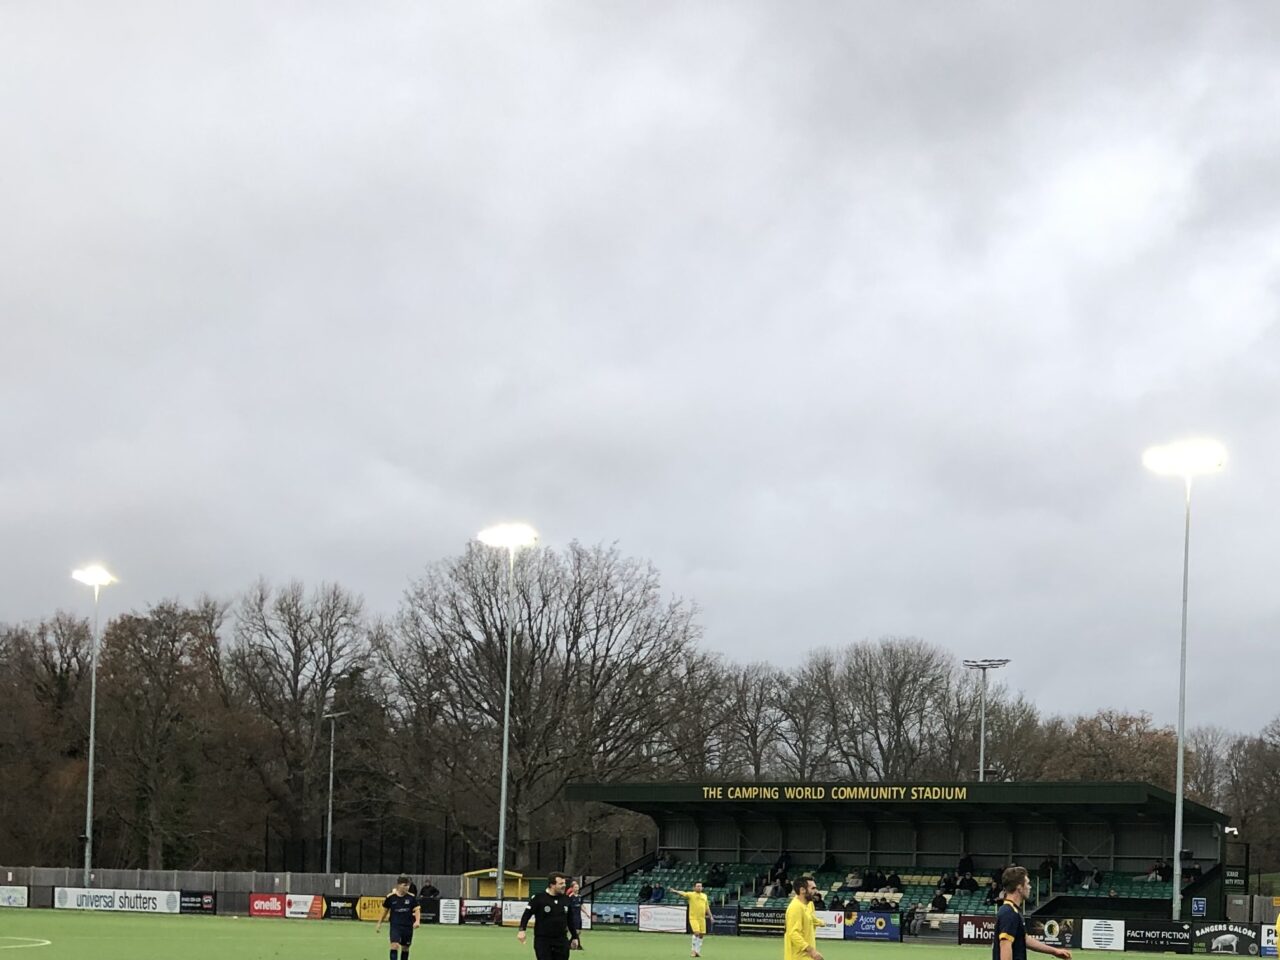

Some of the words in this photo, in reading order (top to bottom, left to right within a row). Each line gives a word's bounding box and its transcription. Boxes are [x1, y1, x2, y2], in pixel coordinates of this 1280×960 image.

[703, 787, 722, 800] THE
[728, 787, 779, 800] CAMPING
[784, 787, 825, 800] WORLD
[831, 787, 906, 800] COMMUNITY
[911, 787, 967, 800] STADIUM
[76, 891, 115, 908] universal
[119, 892, 157, 911] shutters
[254, 897, 282, 910] oneills
[858, 915, 876, 924] Ascot
[860, 922, 876, 930] Care
[1161, 931, 1190, 940] FICTION
[1196, 924, 1227, 937] BANGERS
[1228, 924, 1256, 939] GALORE
